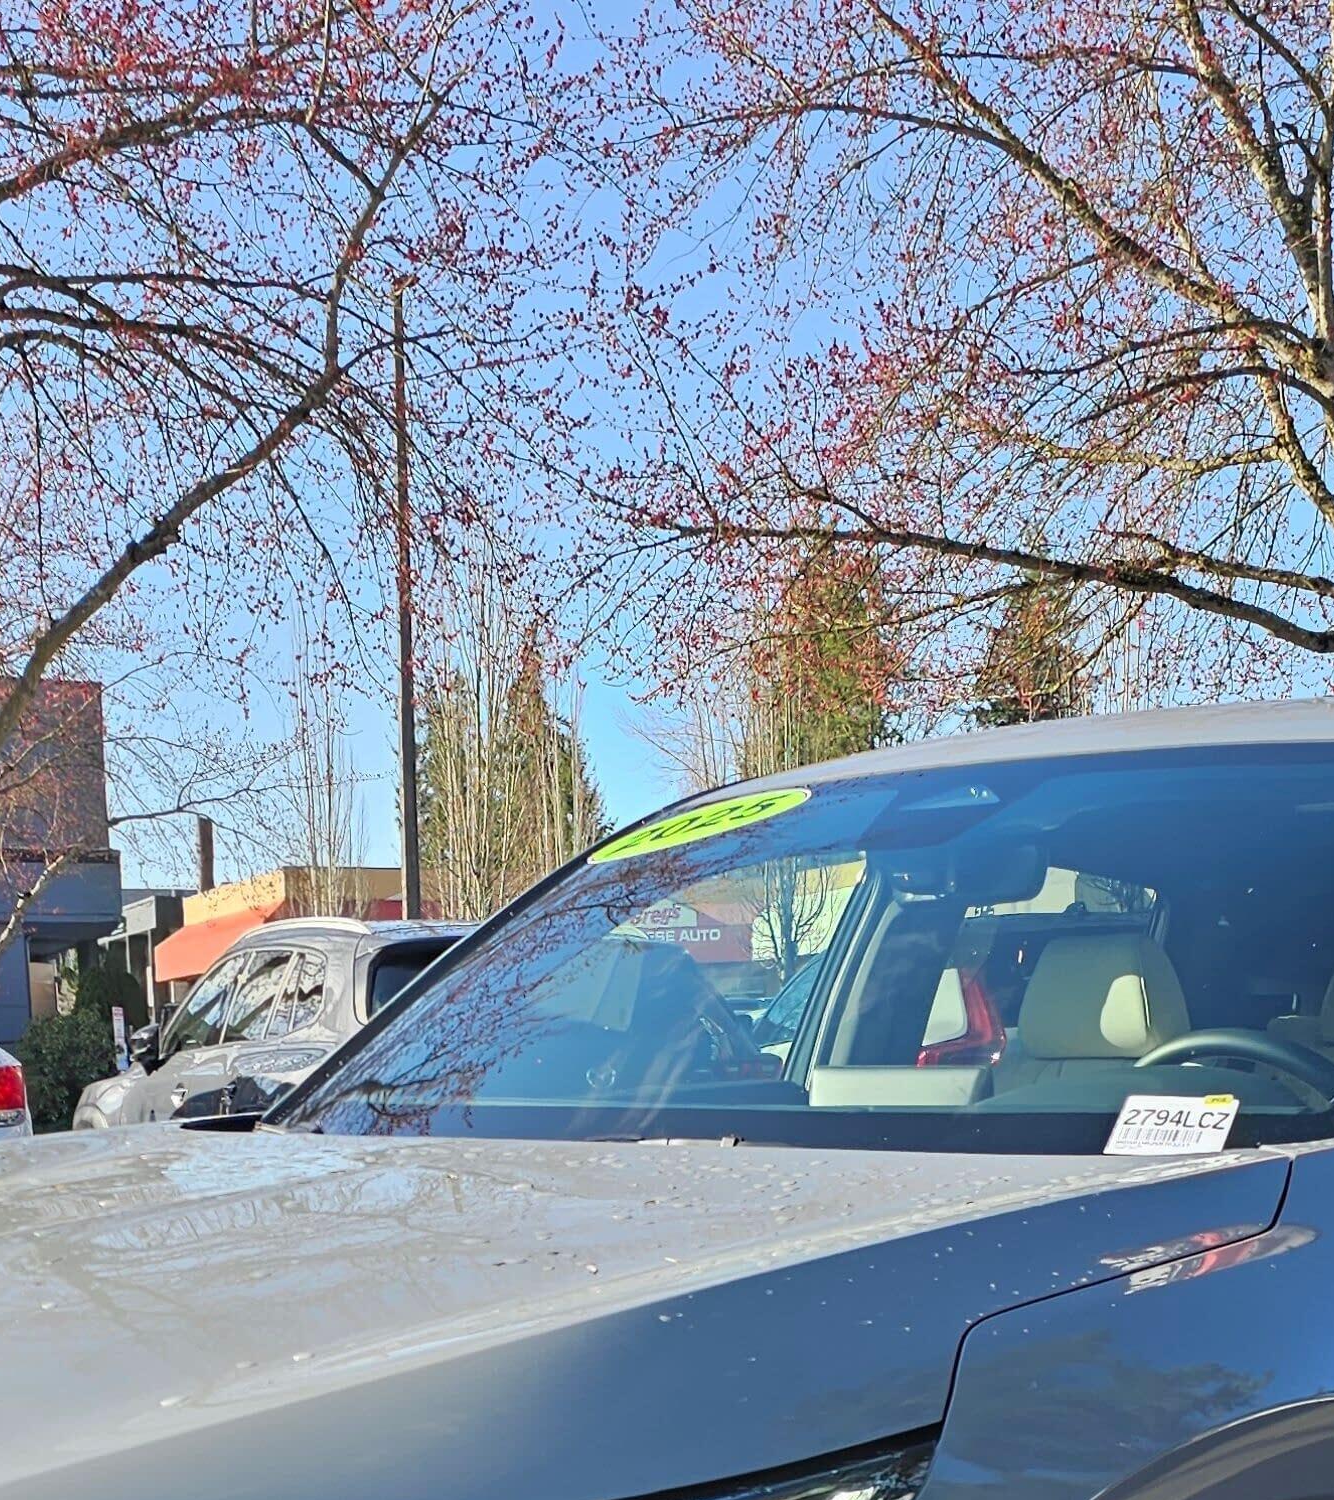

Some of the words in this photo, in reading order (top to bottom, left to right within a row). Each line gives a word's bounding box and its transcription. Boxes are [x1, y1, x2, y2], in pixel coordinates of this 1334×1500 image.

[603, 794, 791, 858] 2025
[678, 929, 721, 942] AUTO
[1123, 1109, 1230, 1130] 2794LCZ
